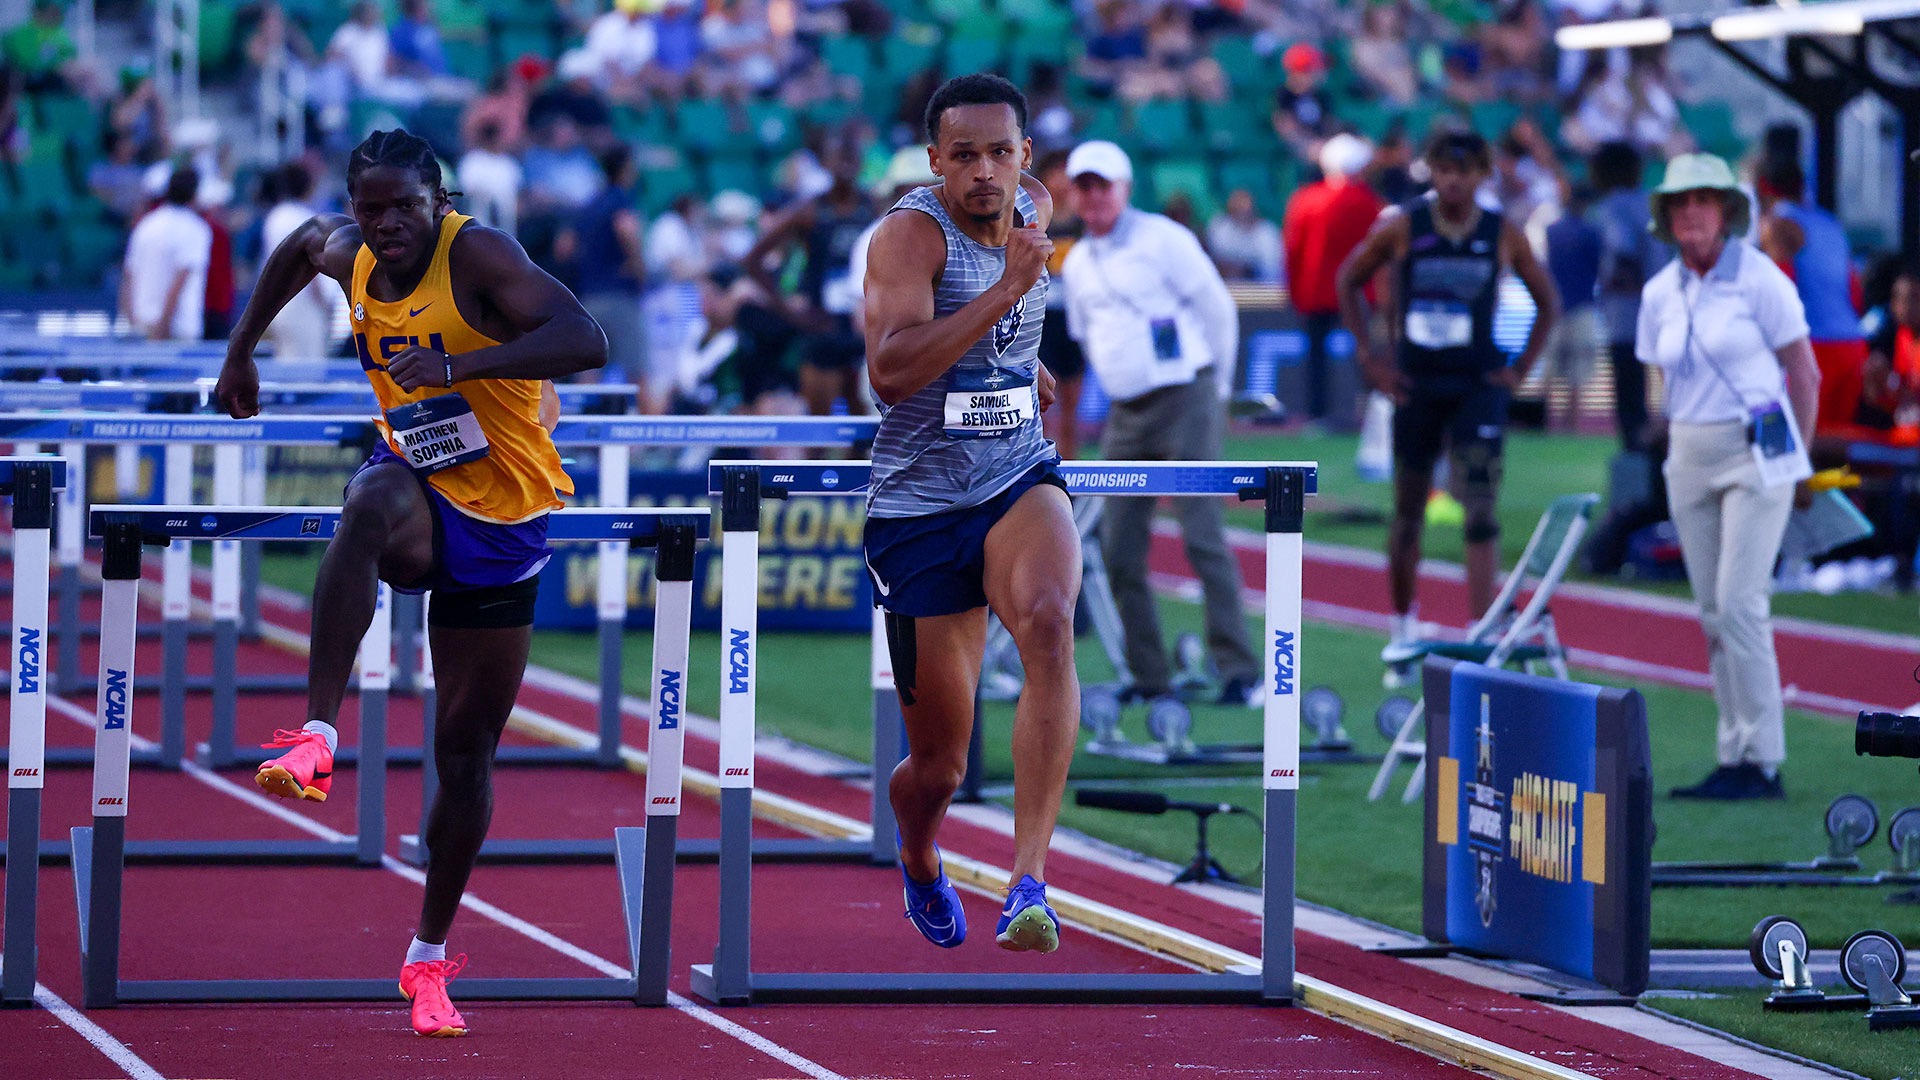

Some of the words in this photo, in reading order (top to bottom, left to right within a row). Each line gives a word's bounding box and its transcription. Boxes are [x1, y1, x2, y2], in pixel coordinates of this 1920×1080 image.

[970, 394, 1011, 409] SAMUEL
[961, 409, 1021, 426] BENNETT
[139, 423, 170, 436] FIELD
[171, 423, 264, 437] CHAMPIONSHIPS
[403, 421, 459, 447] MATTHEW
[687, 425, 779, 439] CHAMPIONSHIPS
[411, 436, 467, 464] SOPHIA
[772, 474, 795, 483] GILL
[1061, 473, 1148, 488] MPIONSHIPS
[1232, 476, 1255, 484] GILL
[165, 519, 189, 527] GILL
[611, 521, 634, 529] GILL
[18, 626, 40, 694] NCAA
[729, 628, 750, 694] NCAA
[1274, 629, 1294, 695] NCAA
[104, 668, 127, 730] NCAA
[658, 669, 681, 730] NCAA
[13, 768, 39, 777] GILL
[724, 767, 750, 776] GILL
[1270, 769, 1295, 777] GILL
[97, 797, 124, 806] GILL
[651, 796, 677, 805] GILL
[1509, 771, 1577, 884] #NCAATF
